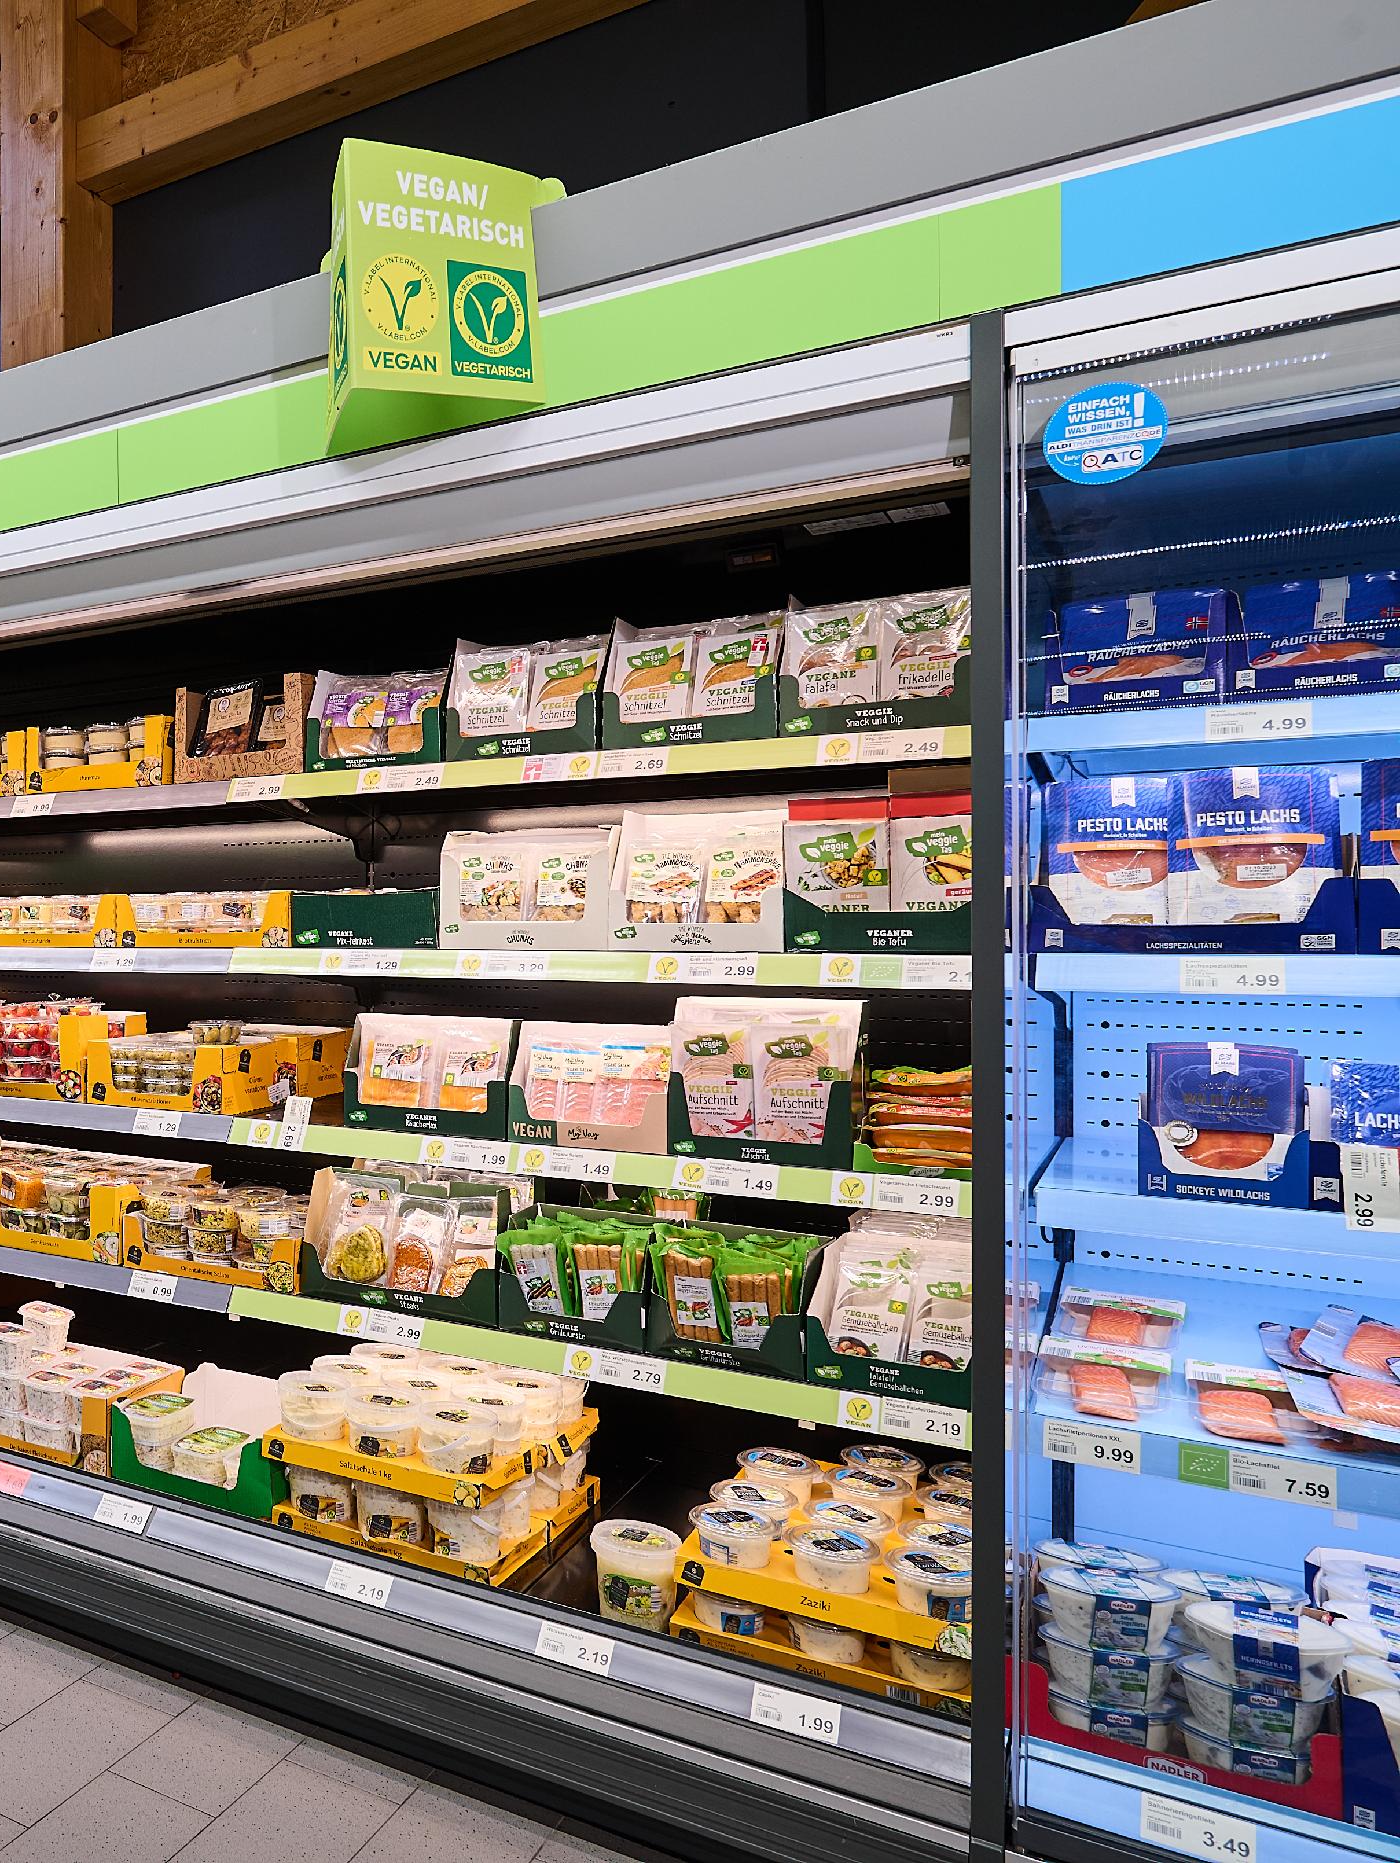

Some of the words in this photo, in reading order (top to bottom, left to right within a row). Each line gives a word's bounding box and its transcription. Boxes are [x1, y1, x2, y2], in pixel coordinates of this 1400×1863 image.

[396, 170, 489, 210] VEGAN/
[358, 201, 524, 248] VEGETARISCH
[364, 261, 385, 295] V-LABEL
[385, 256, 436, 301] INTERNATIONAL
[455, 277, 474, 310] V-LABEL
[474, 273, 522, 318] INTERNATIONAL
[377, 323, 428, 341] V-LABEL.COM
[468, 335, 515, 354] V-LABEL.COM
[368, 350, 438, 373] VEGAN
[454, 360, 531, 379] VEGETARISCH
[1068, 394, 1130, 414] EINFACH
[1068, 405, 1130, 424] WISSEN,
[1067, 426, 1087, 436] WAS
[1091, 422, 1112, 432] DRIN
[1116, 419, 1130, 428] IST
[1271, 632, 1386, 649] RÄUCHERLACHS
[898, 660, 951, 672] VEGGIE
[806, 670, 856, 682] VEGANE
[1295, 674, 1358, 686] RÄUCHERLACHS
[626, 692, 667, 701] VEGGIE
[708, 686, 755, 697] VEGANE
[1103, 690, 1160, 701] RÄUCHERLACHS
[624, 699, 666, 712] Schnitzel
[706, 696, 750, 706] Schnitzel
[469, 705, 508, 715] VEGANE
[539, 709, 576, 719] Schnitze
[855, 708, 893, 717] VEGGIE
[467, 715, 505, 724] Schnitzel
[846, 717, 869, 727] Snack
[872, 716, 887, 725] und
[890, 714, 903, 725] Dip
[1262, 717, 1307, 731] 4.99
[670, 723, 702, 732] VEGGIE
[670, 730, 702, 741] Schnitzel
[502, 738, 530, 746] VEGGIE
[904, 742, 939, 753] 2.49
[502, 745, 530, 754] Schnitzel
[635, 759, 664, 770] 2.69
[415, 776, 439, 786] 2.49
[259, 786, 280, 795] 2.99
[1196, 810, 1245, 827] PESTO
[1250, 808, 1300, 824] LACHS
[1077, 818, 1122, 833] PESTO
[926, 835, 958, 846] veggie
[820, 842, 849, 852] veggie
[905, 901, 968, 911] VEGAN
[872, 938, 886, 946] Bio
[889, 937, 907, 947] Tofu
[1146, 941, 1223, 949] LACHSSPEZIALITÄTEN
[376, 961, 398, 970] 1.29
[724, 966, 755, 976] 2.99
[948, 972, 972, 982] 2.1
[1236, 974, 1280, 987] 4.99
[699, 1040, 722, 1049] veggie
[781, 1042, 806, 1051] veggie
[688, 1084, 733, 1094] VEGGIE
[771, 1087, 818, 1097] VEGGIE
[688, 1094, 738, 1106] Aufschnitt
[771, 1097, 825, 1110] Aufschnitt
[406, 1113, 437, 1121] VEGANER
[1354, 1112, 1400, 1130] LACH
[158, 1122, 176, 1132] 1.29
[512, 1122, 551, 1139] VEGAN
[283, 1125, 296, 1148] 2.69
[481, 1154, 506, 1165] 1.99
[582, 1164, 610, 1175] 1.49
[744, 1178, 773, 1191] 1.49
[1176, 1185, 1215, 1197] SOCKEYE
[1218, 1189, 1270, 1201] WILDLACHS
[919, 1194, 954, 1207] 2.99
[1354, 1193, 1374, 1227] 2.99
[152, 1285, 172, 1298] 0.99
[394, 1293, 424, 1303] VEGANE
[844, 1309, 879, 1320] VEGANE
[396, 1326, 421, 1340] 2.99
[925, 1321, 962, 1333] VEGANE
[632, 1369, 661, 1384] 2.79
[869, 1365, 900, 1376] VEGANE
[845, 1420, 872, 1428] VEGAN
[926, 1419, 960, 1436] 2.19
[1093, 1445, 1134, 1464] 9.99
[383, 1471, 392, 1480] kg
[1284, 1478, 1330, 1499] 7.59
[122, 1511, 143, 1525] 1.99
[357, 1584, 384, 1600] 2.19
[800, 1595, 831, 1612] Zaziki
[577, 1647, 609, 1665] 2.19
[795, 1663, 826, 1679] Zaziki
[798, 1714, 834, 1734] 1.99
[1151, 1762, 1200, 1781] NADLER
[1203, 1831, 1251, 1858] 3.49
